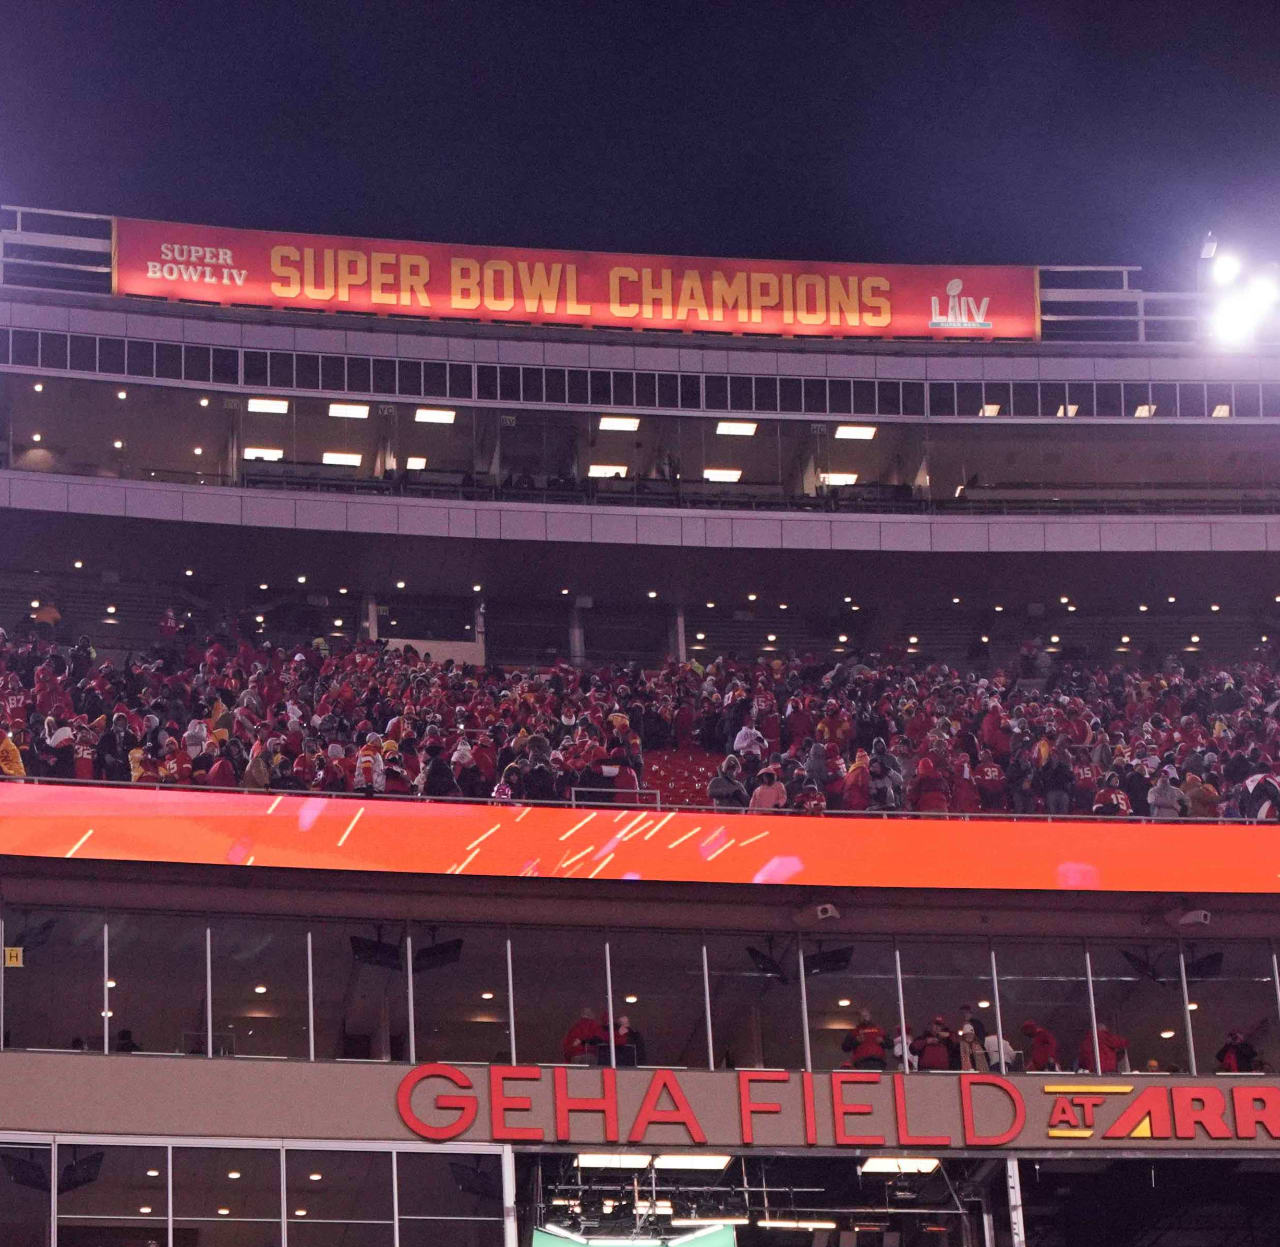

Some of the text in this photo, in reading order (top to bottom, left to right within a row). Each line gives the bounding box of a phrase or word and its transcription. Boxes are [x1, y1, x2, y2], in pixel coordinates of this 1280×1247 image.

[161, 243, 233, 267] SUPER
[147, 261, 248, 286] BOWL IV
[271, 246, 891, 328] SUPER BOWL CHAMPIONS
[10, 950, 19, 962] H
[396, 1063, 707, 1143] GEHA
[738, 1071, 1026, 1146] FIELD
[1049, 1096, 1106, 1128] AT
